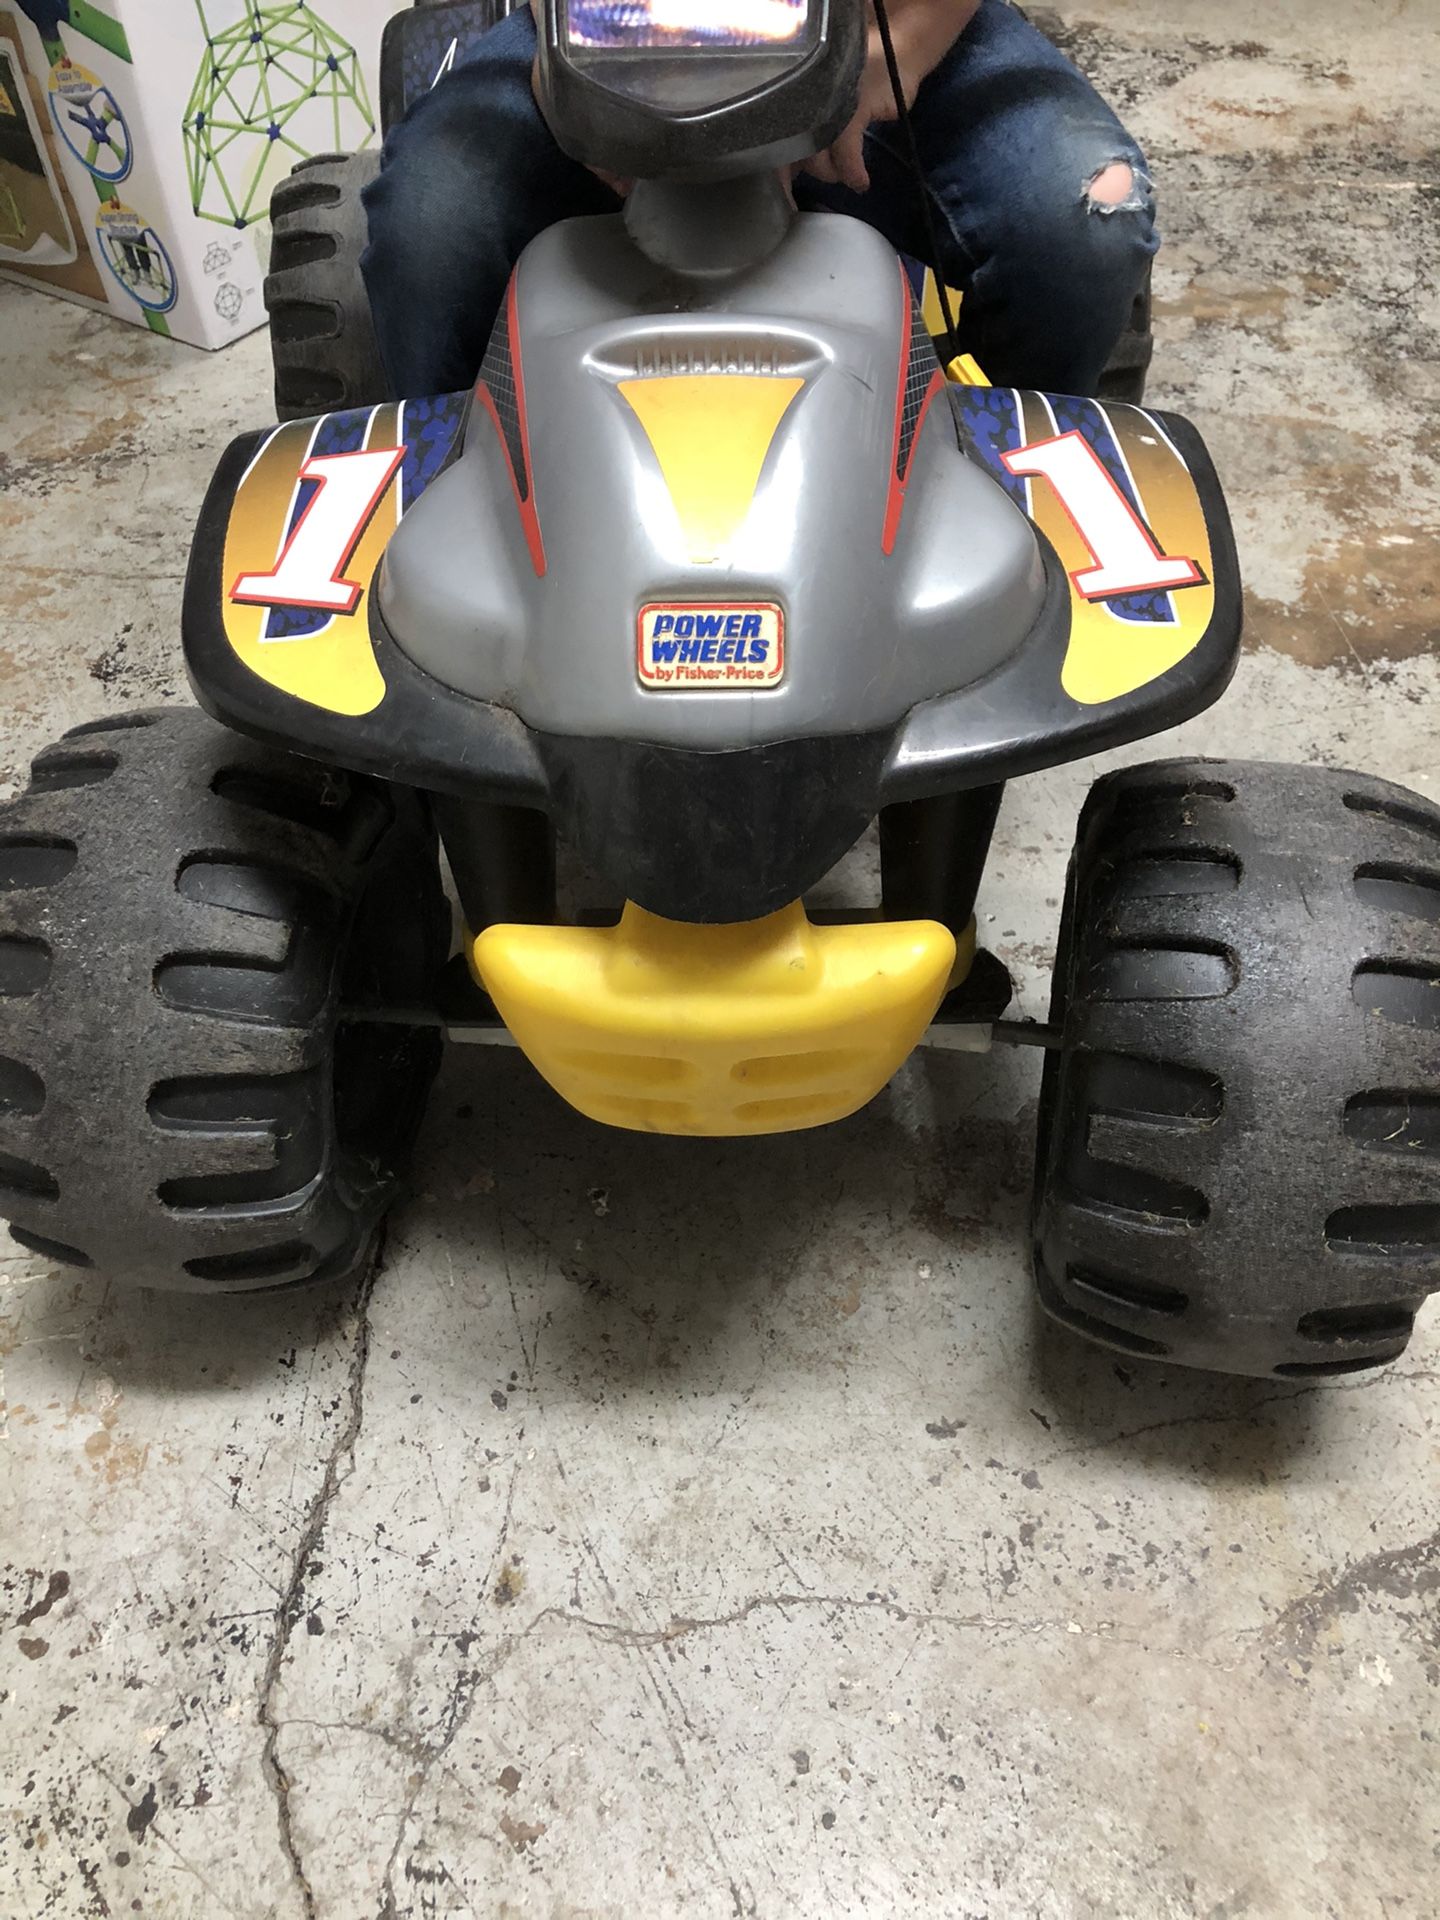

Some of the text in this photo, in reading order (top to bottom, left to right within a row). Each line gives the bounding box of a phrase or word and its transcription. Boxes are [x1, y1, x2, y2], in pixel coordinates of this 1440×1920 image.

[1000, 429, 1206, 602] 1
[228, 446, 408, 614] 1
[652, 614, 763, 638] POWER
[652, 639, 770, 663] WHEELS
[655, 665, 765, 682] by Fisher-Price
